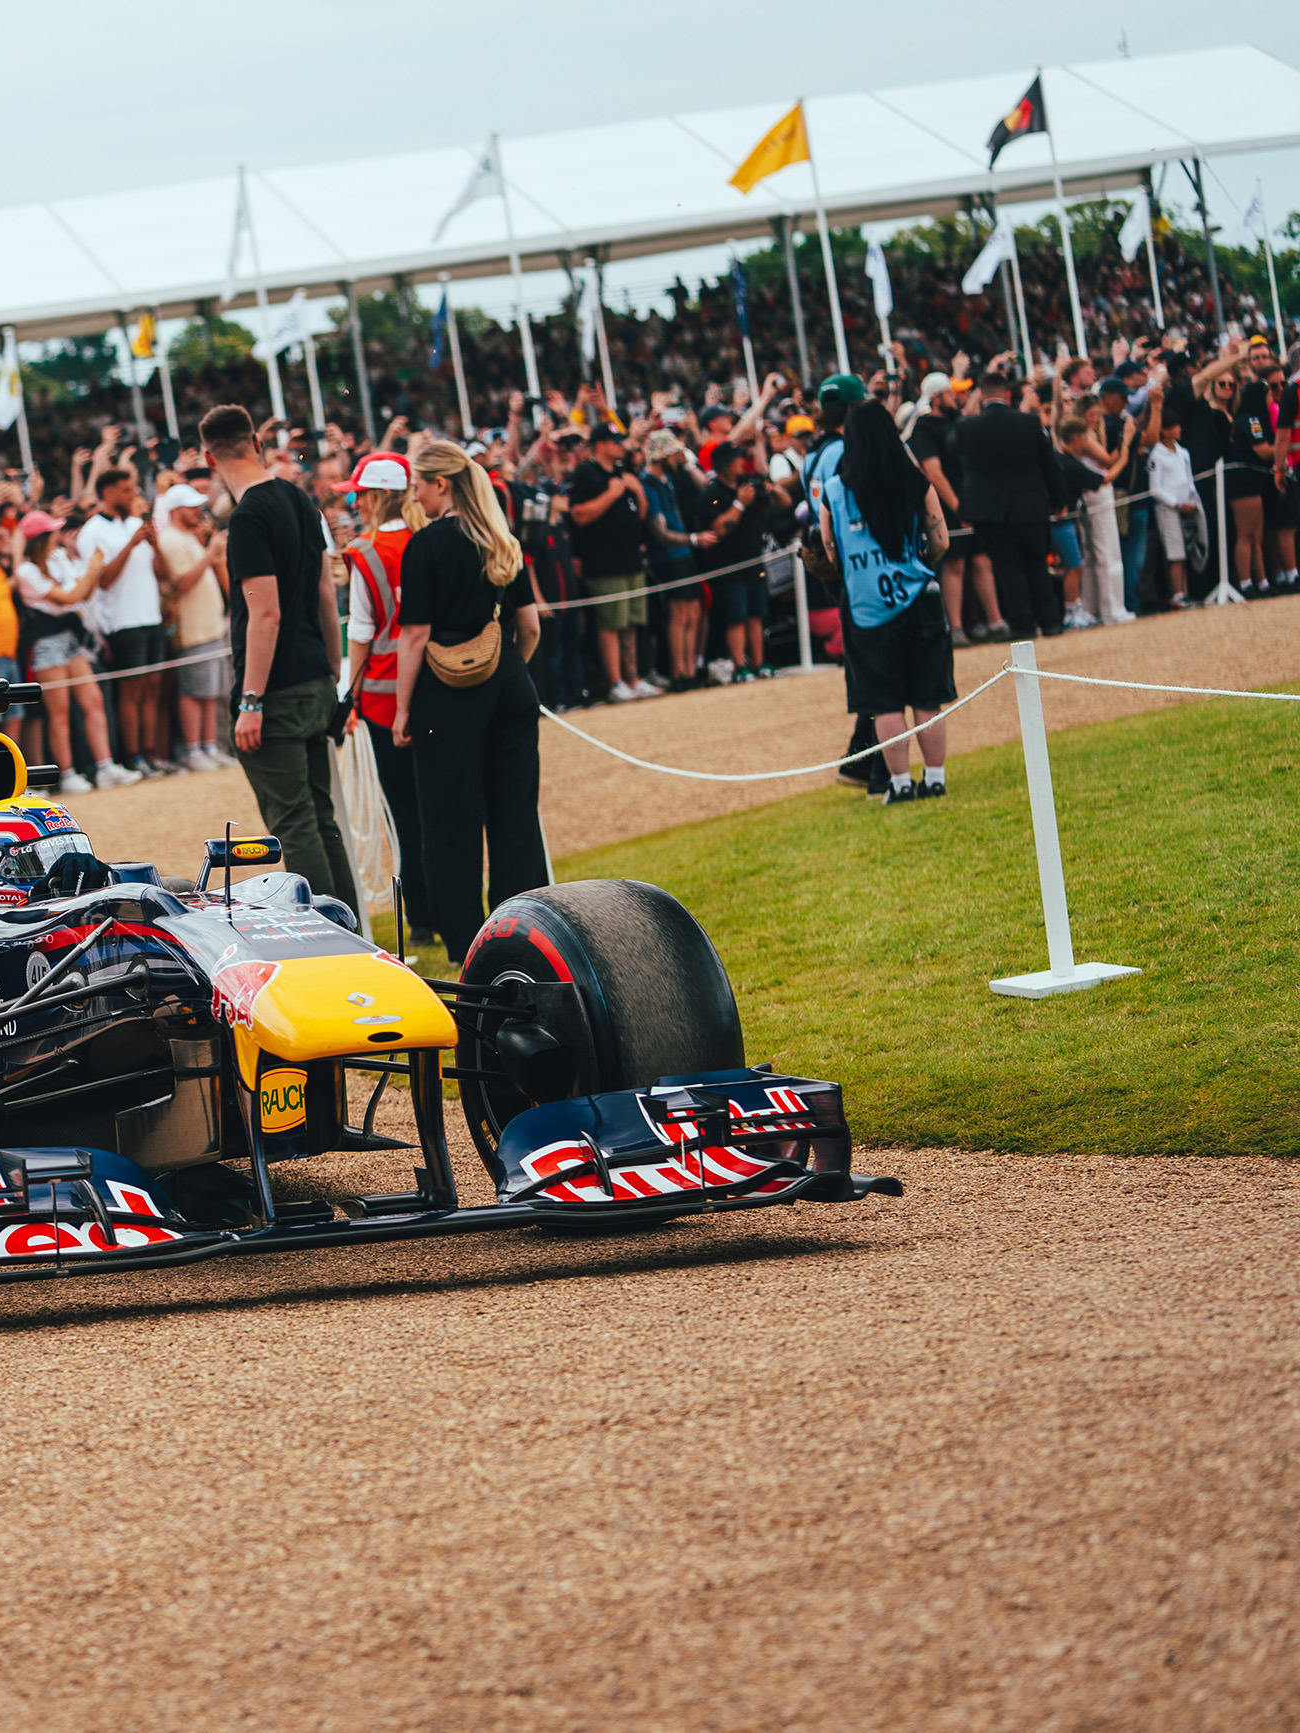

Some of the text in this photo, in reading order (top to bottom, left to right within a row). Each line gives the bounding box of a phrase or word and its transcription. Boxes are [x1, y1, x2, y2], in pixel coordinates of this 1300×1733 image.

[849, 551, 868, 571] TV
[21, 846, 32, 854] LG
[241, 846, 266, 855] RAUCH
